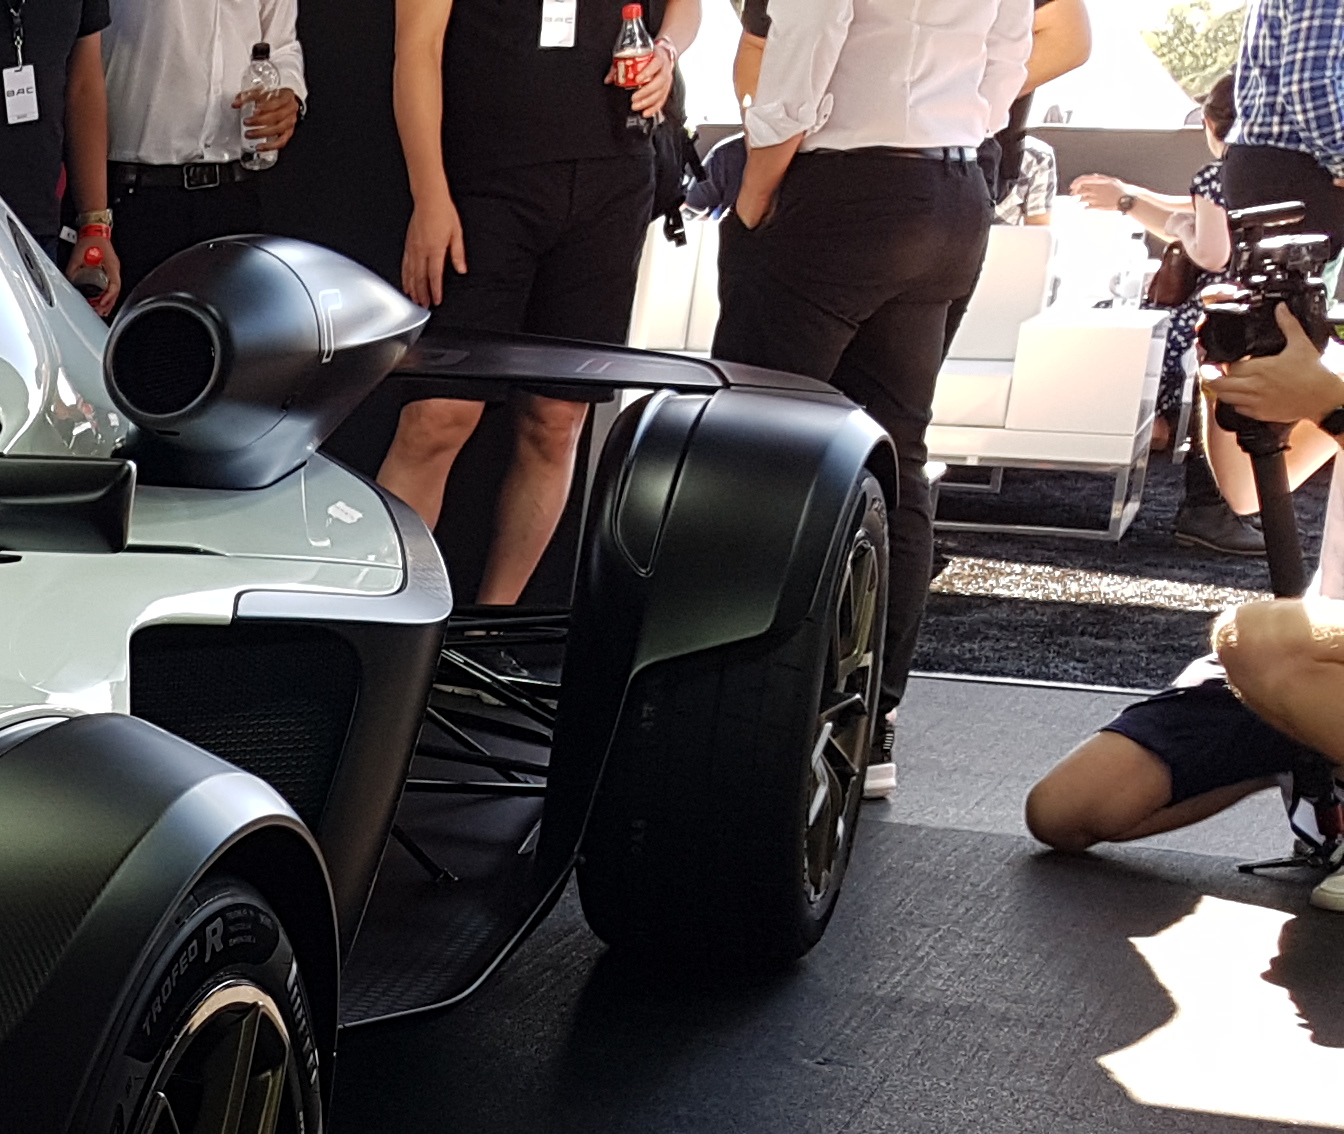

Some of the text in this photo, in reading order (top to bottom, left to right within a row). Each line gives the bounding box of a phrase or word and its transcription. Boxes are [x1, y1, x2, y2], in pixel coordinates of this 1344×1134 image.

[6, 86, 34, 98] BAC
[142, 916, 224, 1036] TROFEO R
